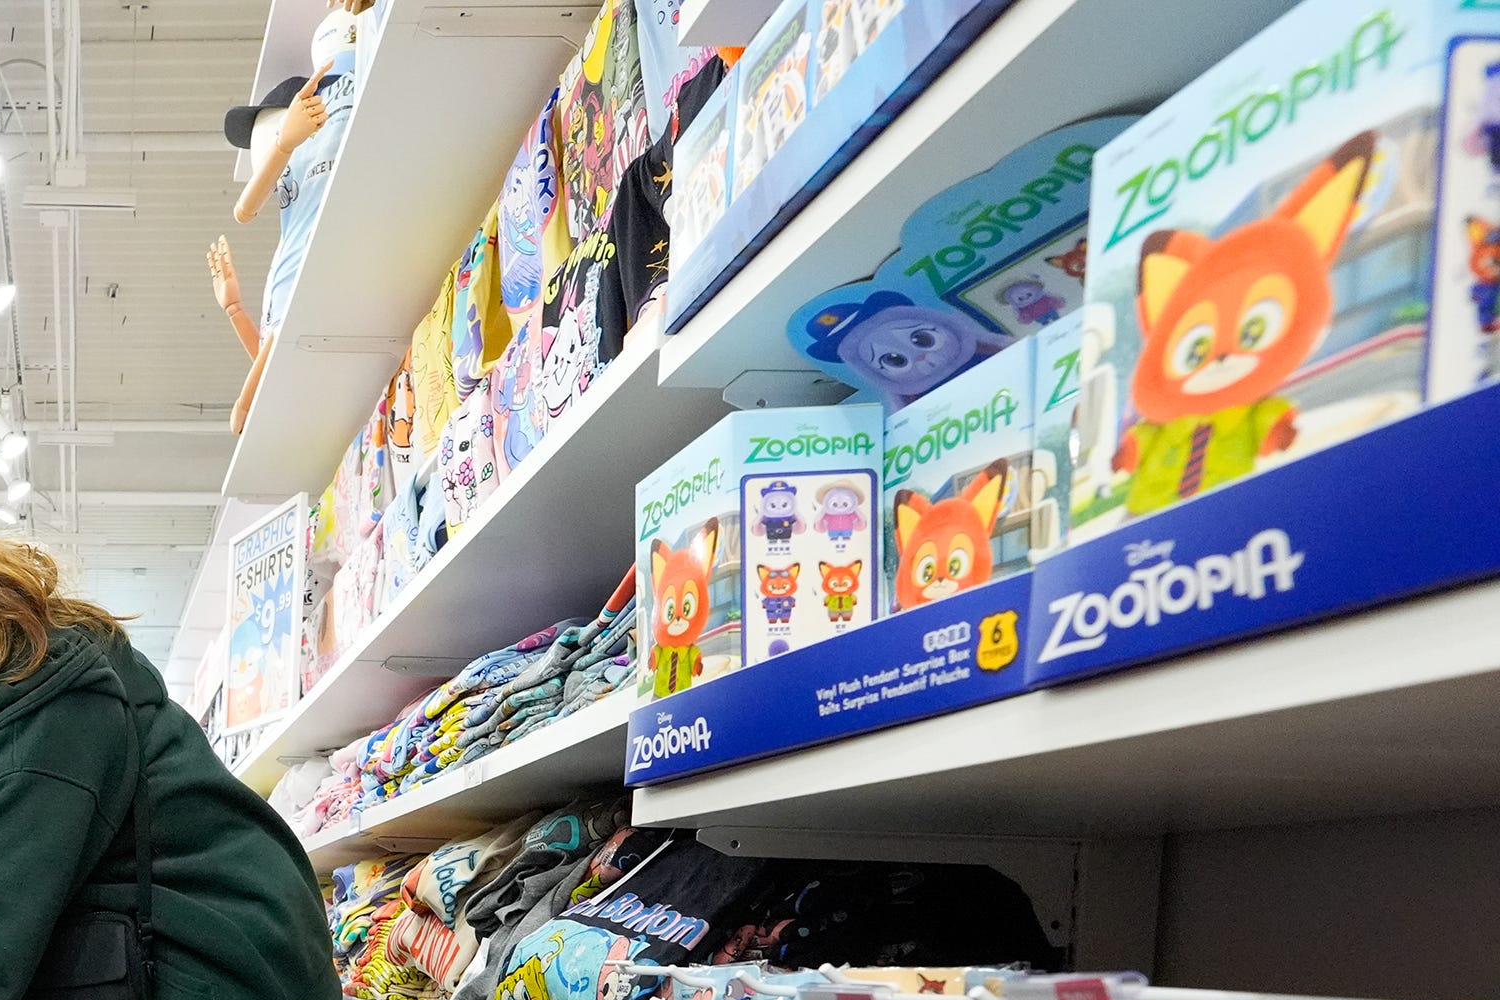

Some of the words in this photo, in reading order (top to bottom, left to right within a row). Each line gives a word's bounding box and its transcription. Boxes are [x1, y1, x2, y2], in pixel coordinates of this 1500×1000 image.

[1103, 8, 1408, 252] ZOOTOPIA
[743, 432, 876, 465] ZOOTOPIA
[885, 388, 1019, 492] ZOOTOPIA
[639, 457, 725, 543] ZOOTOPIA
[237, 511, 295, 565] GRAPHIC
[1123, 539, 1176, 567] Disney
[236, 543, 294, 597] T-SHIRTS
[1037, 528, 1305, 664] ZOOTOPIA
[255, 590, 292, 646] $9.99
[991, 618, 1003, 644] 6
[816, 685, 837, 702] Vinyl
[839, 678, 862, 696] Plush
[863, 668, 900, 688] Pendant
[902, 655, 946, 678] Surprise
[948, 648, 971, 664] Box
[843, 691, 879, 711] Surprise
[881, 675, 927, 699] Pendentif
[930, 667, 971, 686] Peluche
[629, 716, 712, 773] ZOOTOPIA
[656, 712, 673, 725] Disney
[598, 892, 710, 951] Bottom
